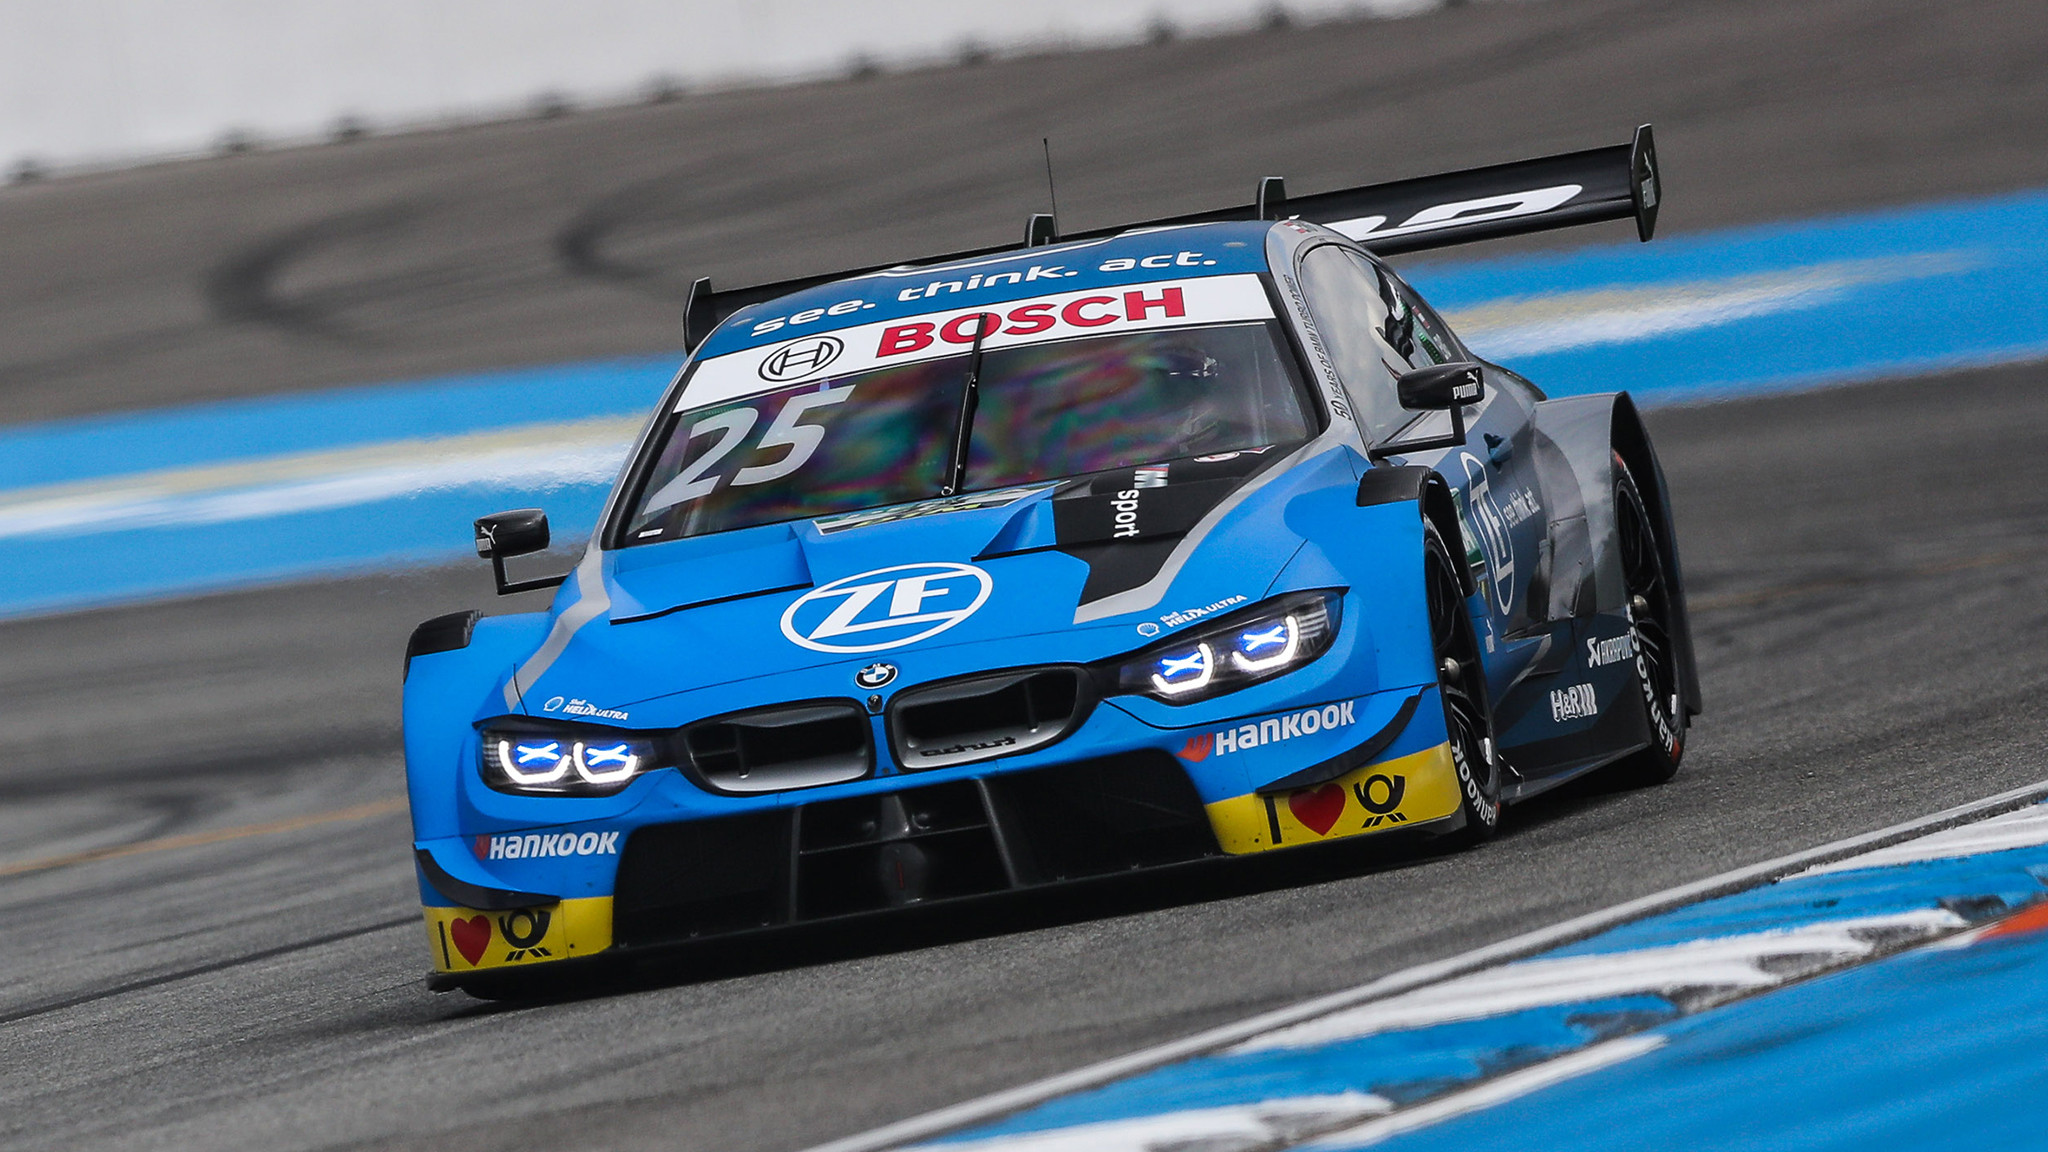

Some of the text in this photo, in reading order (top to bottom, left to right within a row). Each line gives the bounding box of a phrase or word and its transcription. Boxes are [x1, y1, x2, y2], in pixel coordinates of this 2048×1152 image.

[750, 250, 1218, 337] see. think. act.
[875, 286, 1186, 358] BOSCH
[642, 384, 856, 516] 25
[1110, 489, 1140, 538] sport
[803, 569, 977, 640] ZF
[1165, 594, 1248, 628] HELIX ULTRA
[562, 703, 629, 720] HELIX ULTRA
